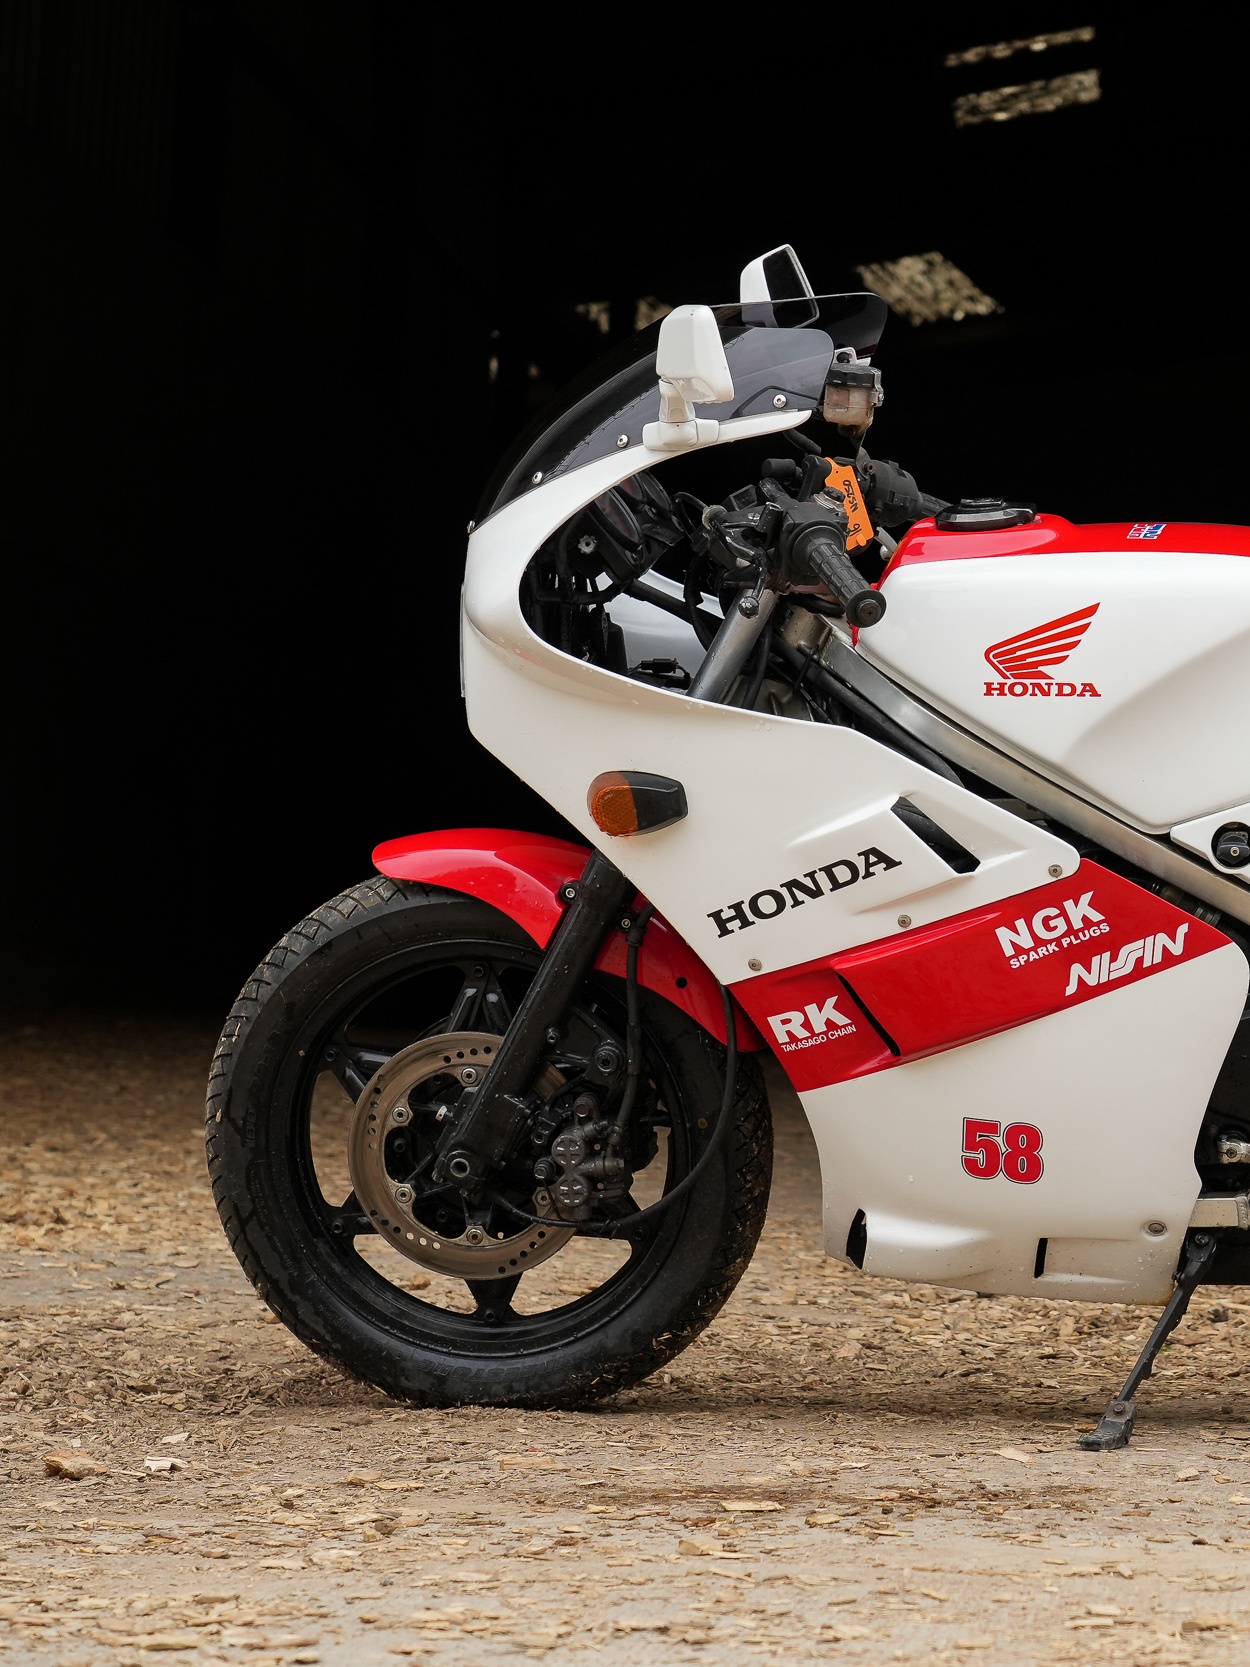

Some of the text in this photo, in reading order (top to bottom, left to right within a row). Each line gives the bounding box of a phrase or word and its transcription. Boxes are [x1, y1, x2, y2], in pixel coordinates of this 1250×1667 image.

[842, 479, 859, 514] NS250
[983, 681, 1102, 697] HONDA
[707, 846, 902, 939] HONDA
[995, 890, 1107, 958] NGK
[1009, 922, 1110, 969] SPARK PLUGS
[1064, 923, 1190, 998] NISSIN
[767, 995, 853, 1044] RK
[781, 1024, 857, 1053] TAKASAGO CHAIN
[961, 1116, 1045, 1185] 58
